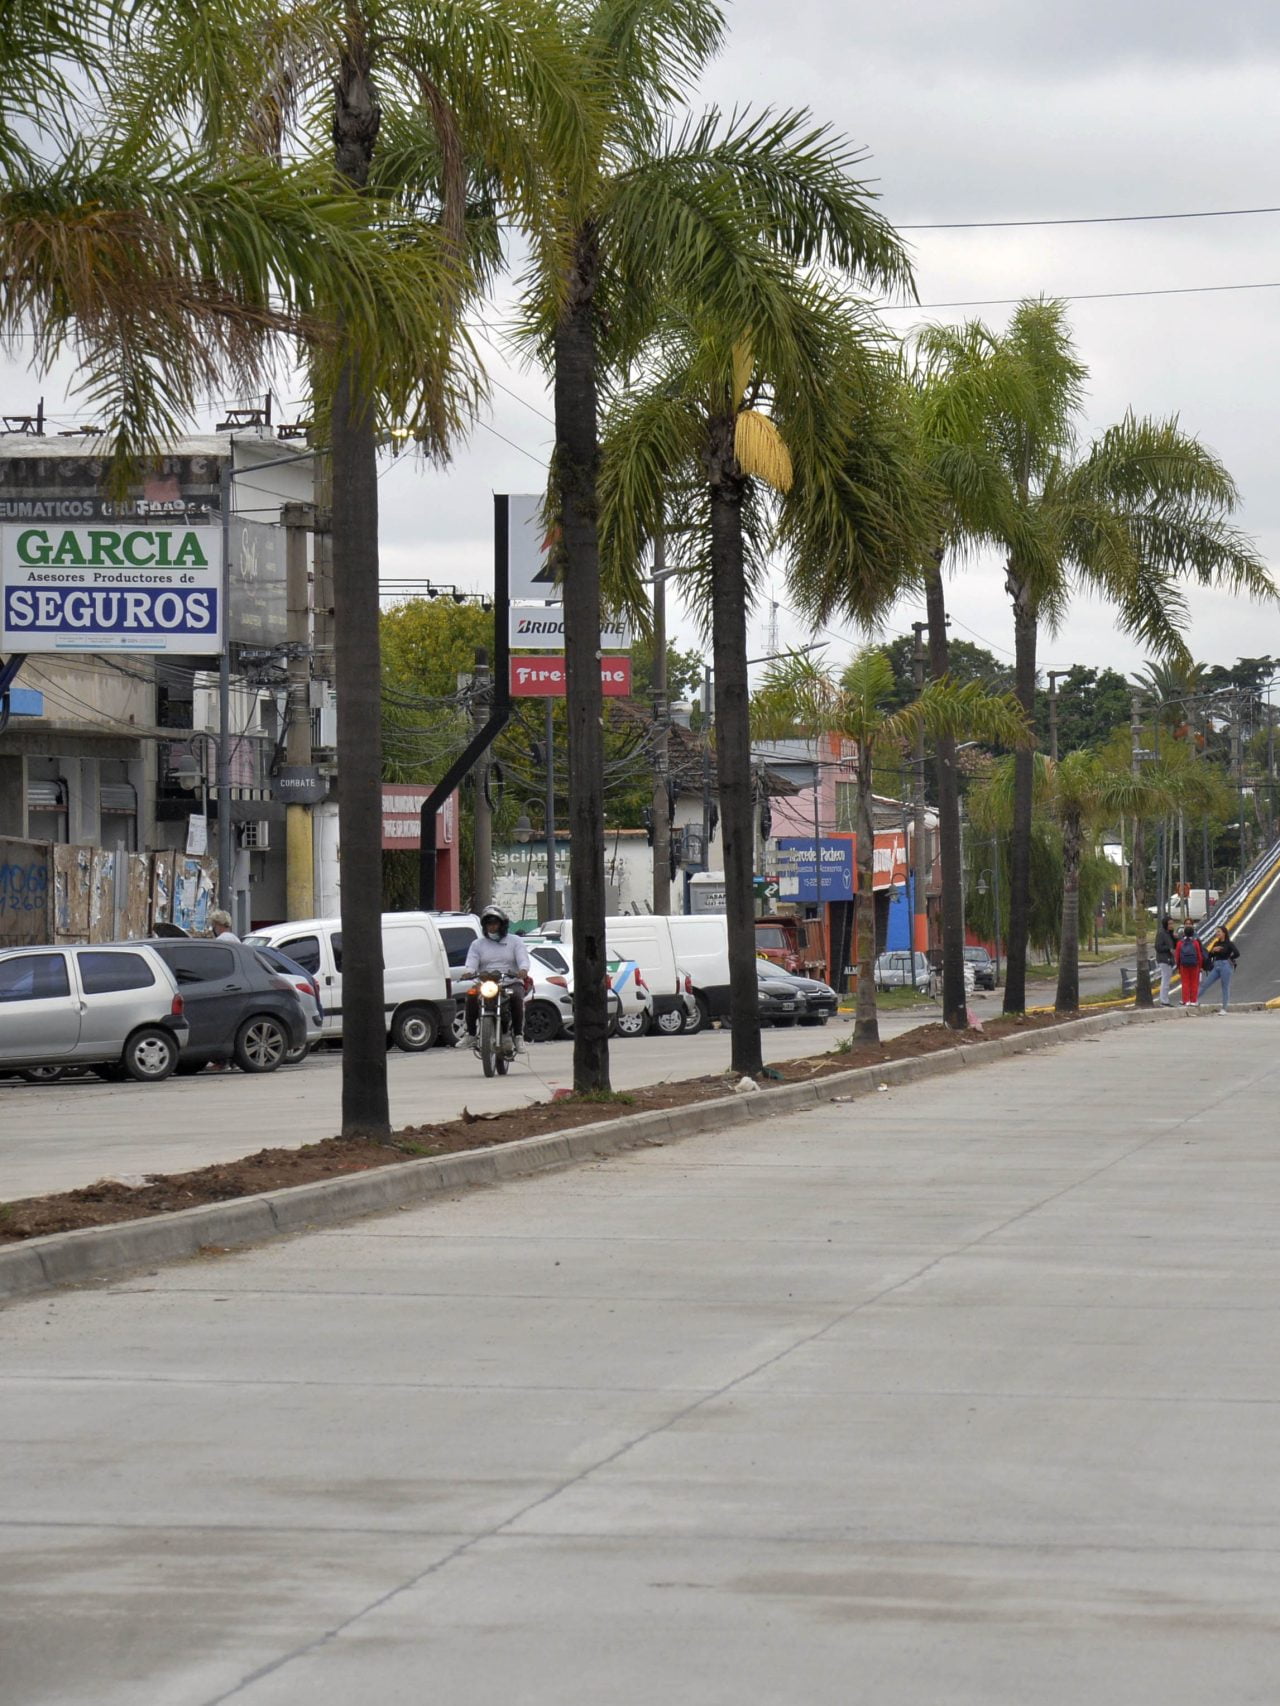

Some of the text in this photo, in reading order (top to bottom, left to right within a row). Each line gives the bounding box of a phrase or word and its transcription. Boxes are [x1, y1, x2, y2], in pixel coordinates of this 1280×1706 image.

[17, 529, 208, 566] GARCIA
[27, 572, 195, 584] Asesores Productores de
[9, 590, 210, 628] SEGUROS
[280, 778, 316, 787] COMBATE
